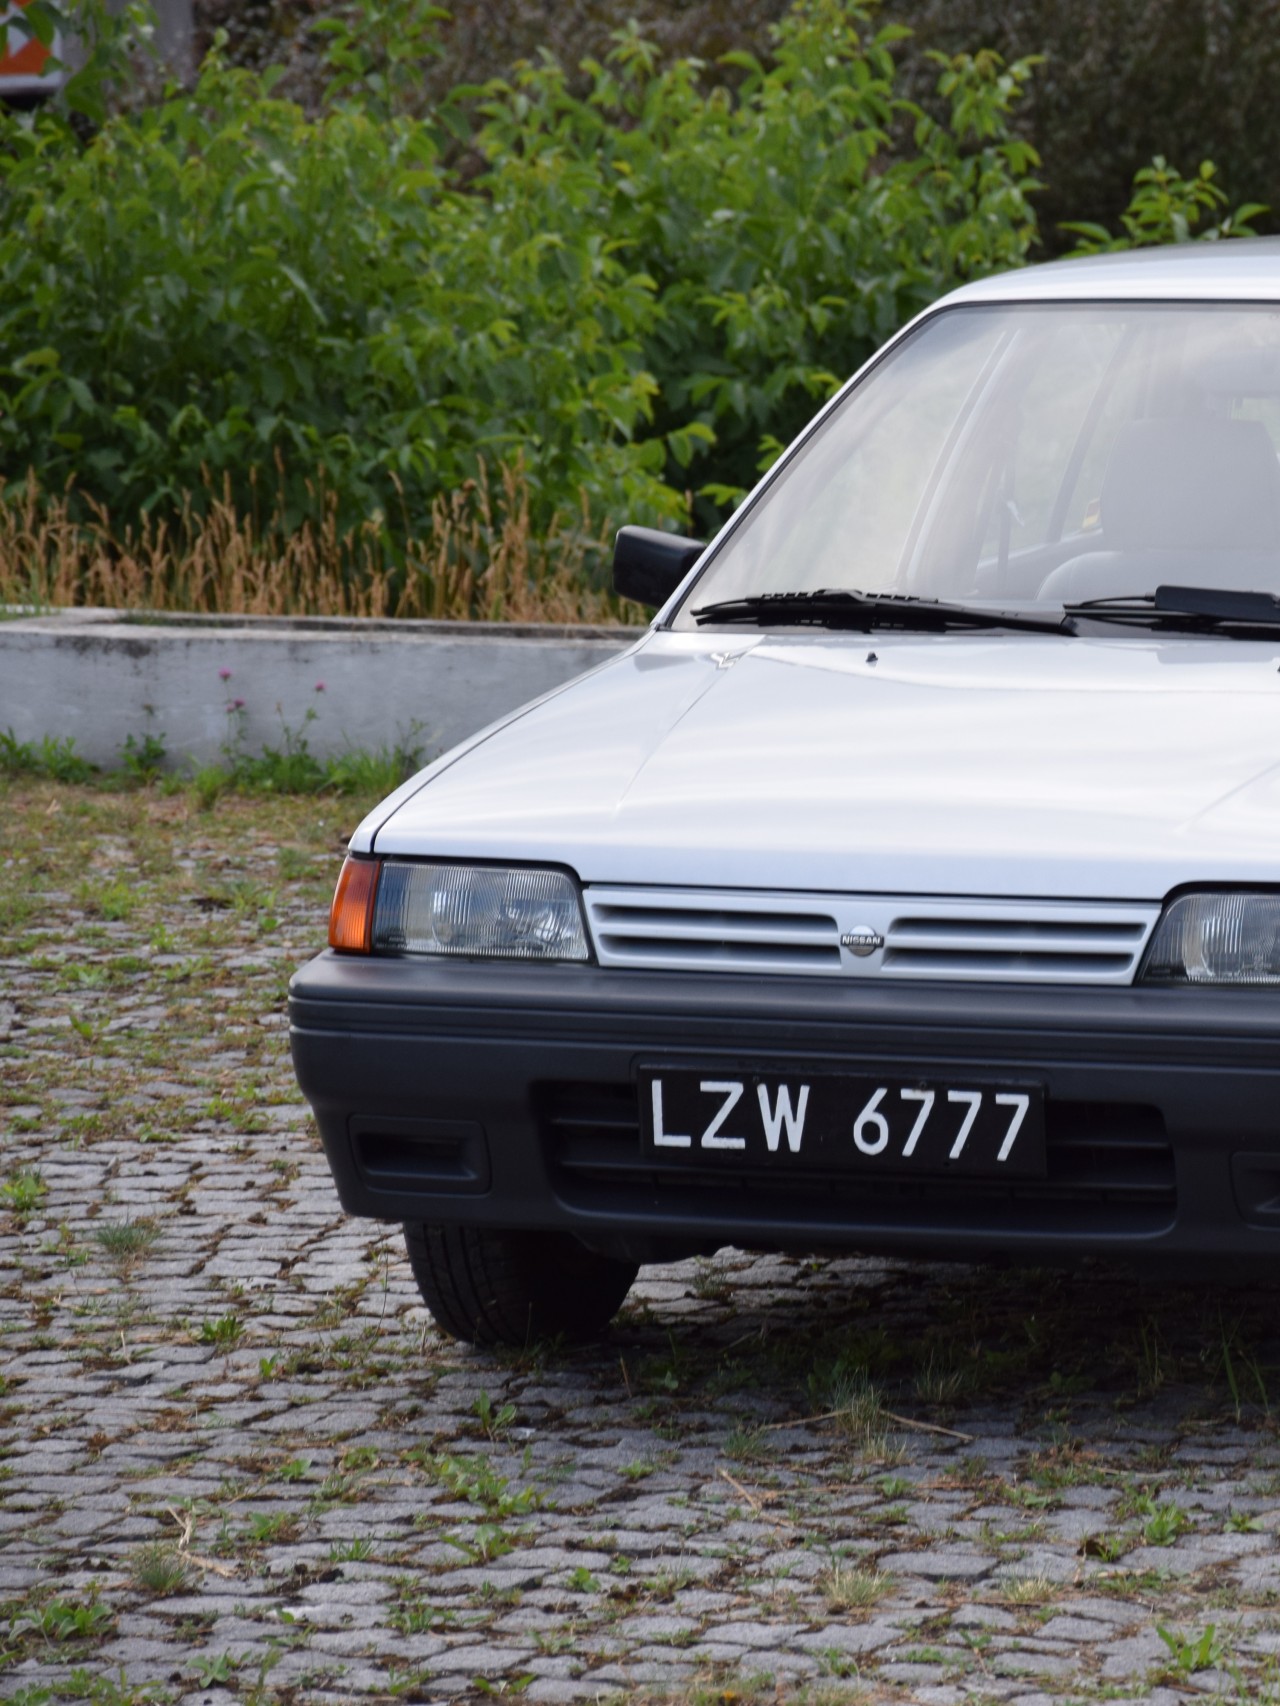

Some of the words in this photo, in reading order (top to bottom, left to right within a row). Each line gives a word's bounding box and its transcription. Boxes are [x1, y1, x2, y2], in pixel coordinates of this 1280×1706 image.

[842, 934, 881, 945] NISSAN
[651, 1079, 810, 1153] LZW
[853, 1087, 1030, 1161] 6777
